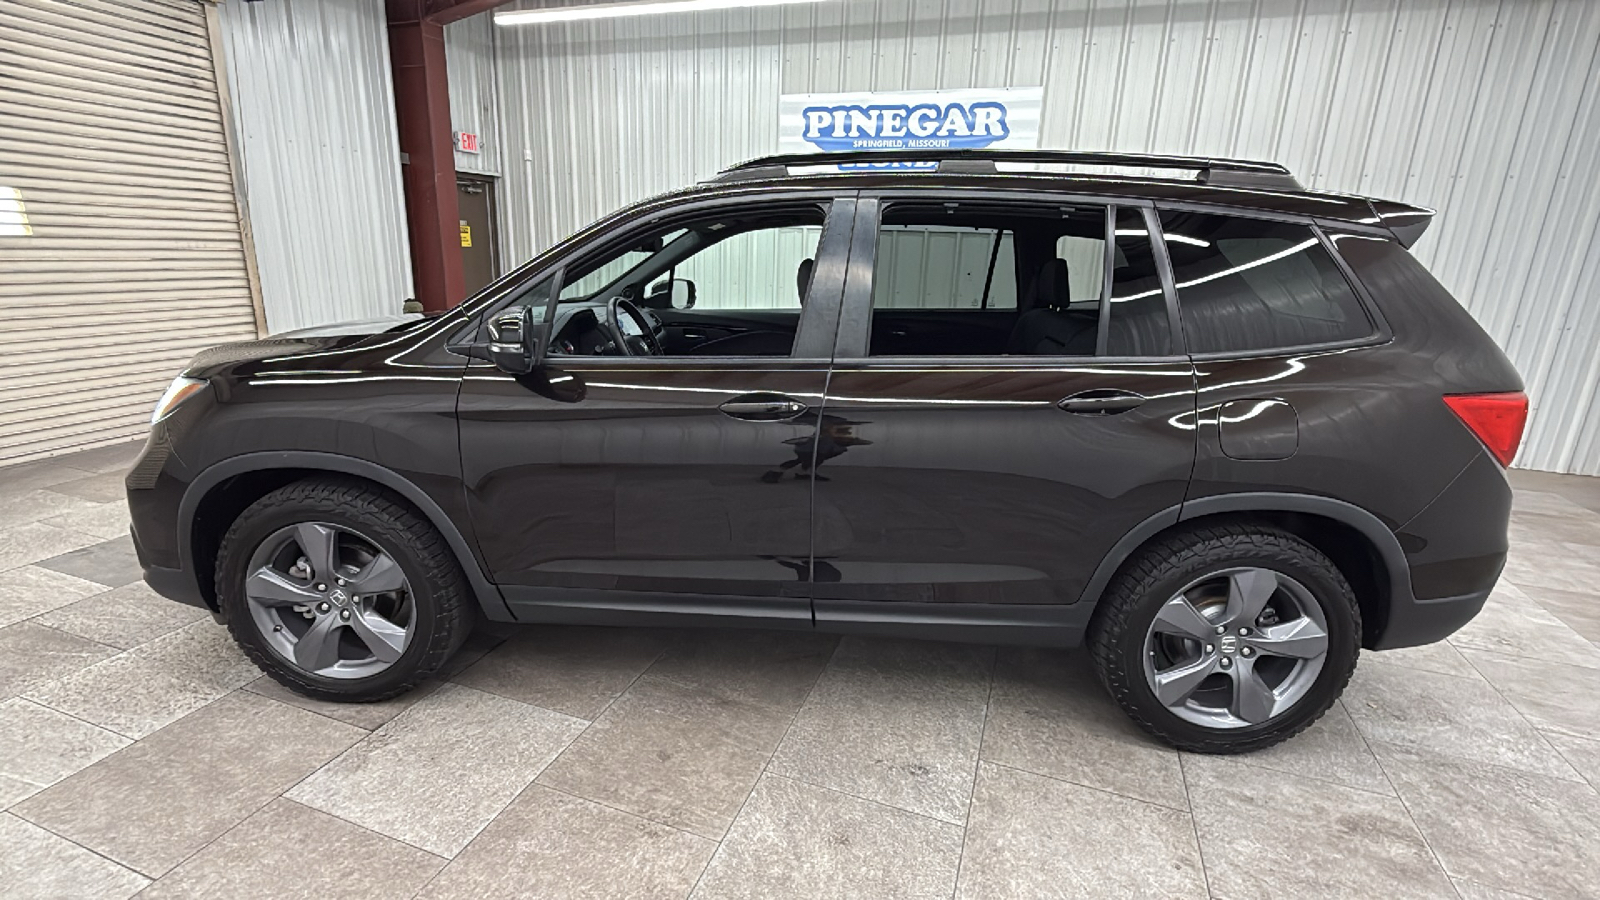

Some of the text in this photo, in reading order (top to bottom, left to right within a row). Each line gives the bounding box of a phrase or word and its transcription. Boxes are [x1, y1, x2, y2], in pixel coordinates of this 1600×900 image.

[807, 107, 1005, 138] PINEGAR
[462, 132, 477, 151] EXIT
[852, 139, 950, 149] SPRINGFIELD, MISSOURI
